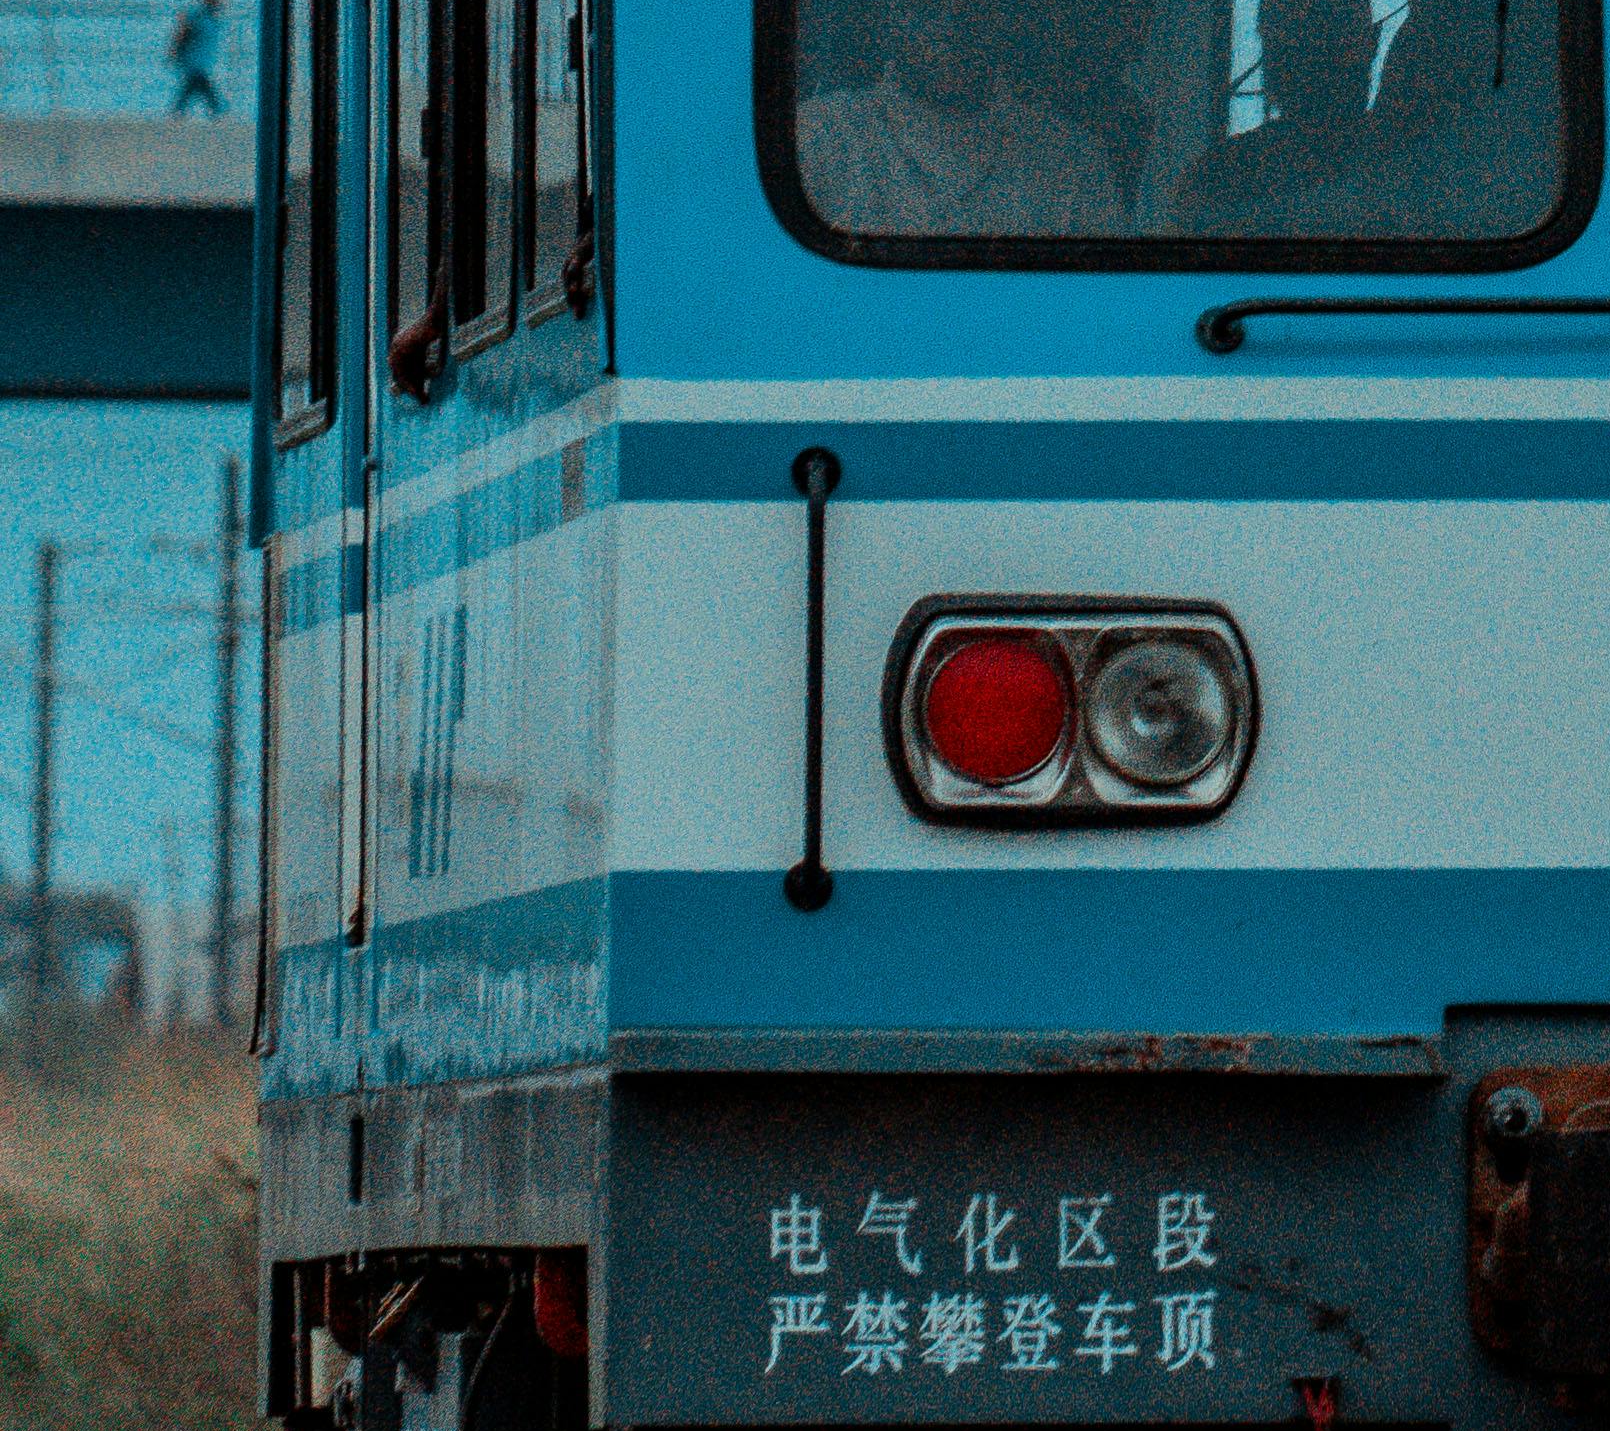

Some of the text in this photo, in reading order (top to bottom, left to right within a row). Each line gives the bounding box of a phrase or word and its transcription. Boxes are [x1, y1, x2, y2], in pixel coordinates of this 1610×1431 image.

[769, 1190, 1217, 1276] 电气化区段
[764, 1289, 1217, 1376] 严禁攀登车顶
